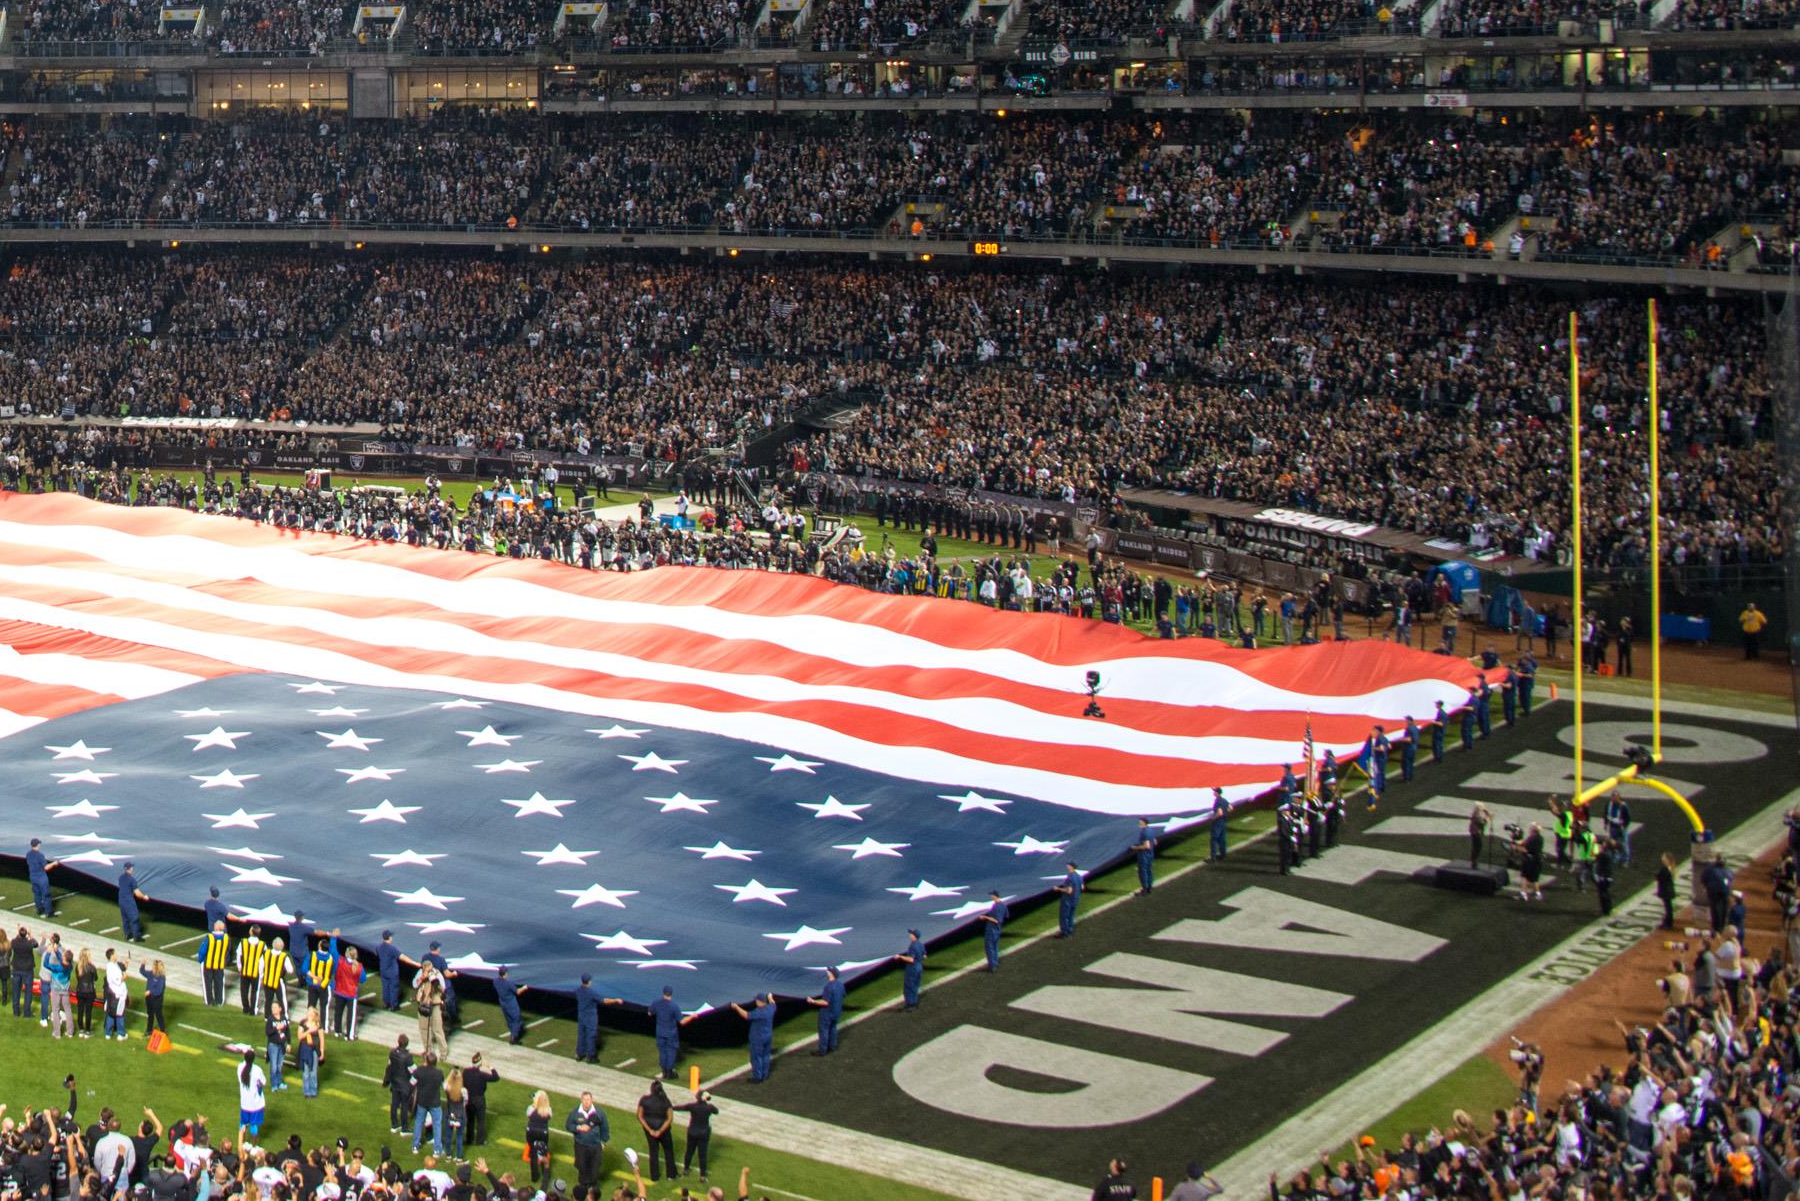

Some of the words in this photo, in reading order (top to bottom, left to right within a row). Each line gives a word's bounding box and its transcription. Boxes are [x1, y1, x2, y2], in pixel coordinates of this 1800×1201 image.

[1025, 52, 1047, 61] BILL
[975, 243, 998, 254] 0:00
[1244, 524, 1321, 549] OAKLAND
[1119, 540, 1153, 550] OAKLAND
[1157, 545, 1188, 558] RAIDERS
[892, 721, 1770, 1129] OAKLAND
[1528, 919, 1653, 985] SERVICE
[1109, 1184, 1132, 1194] STAFF
